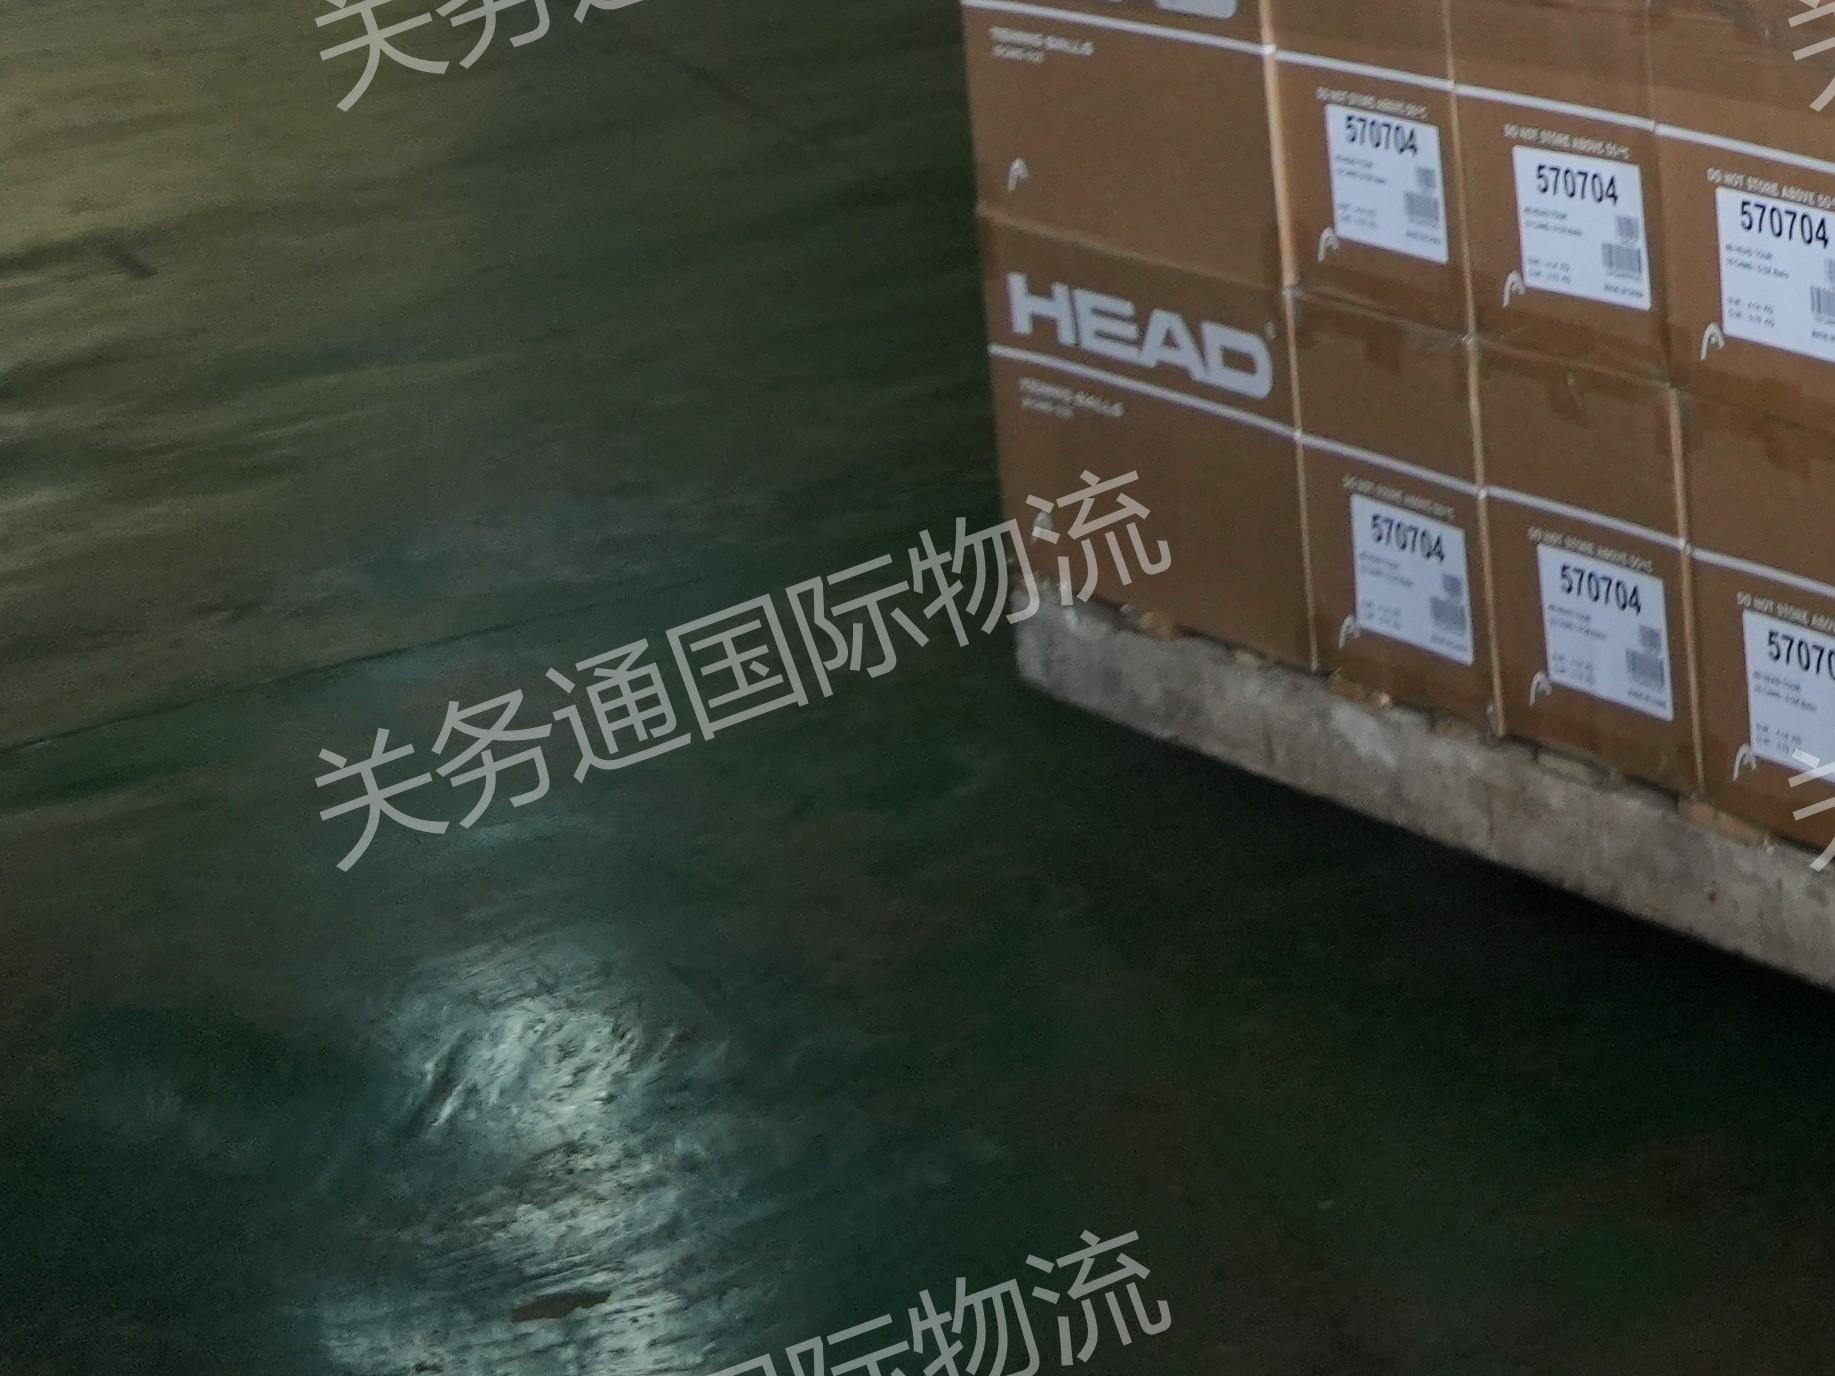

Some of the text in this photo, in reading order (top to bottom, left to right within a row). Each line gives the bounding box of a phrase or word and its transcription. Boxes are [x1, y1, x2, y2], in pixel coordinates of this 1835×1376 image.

[1345, 115, 1418, 156] 570704
[1536, 164, 1618, 206] 570704
[1740, 200, 1829, 248] 570704
[1007, 272, 1274, 400] HEAD
[1370, 514, 1446, 563] 570704
[1561, 563, 1641, 616] 570704
